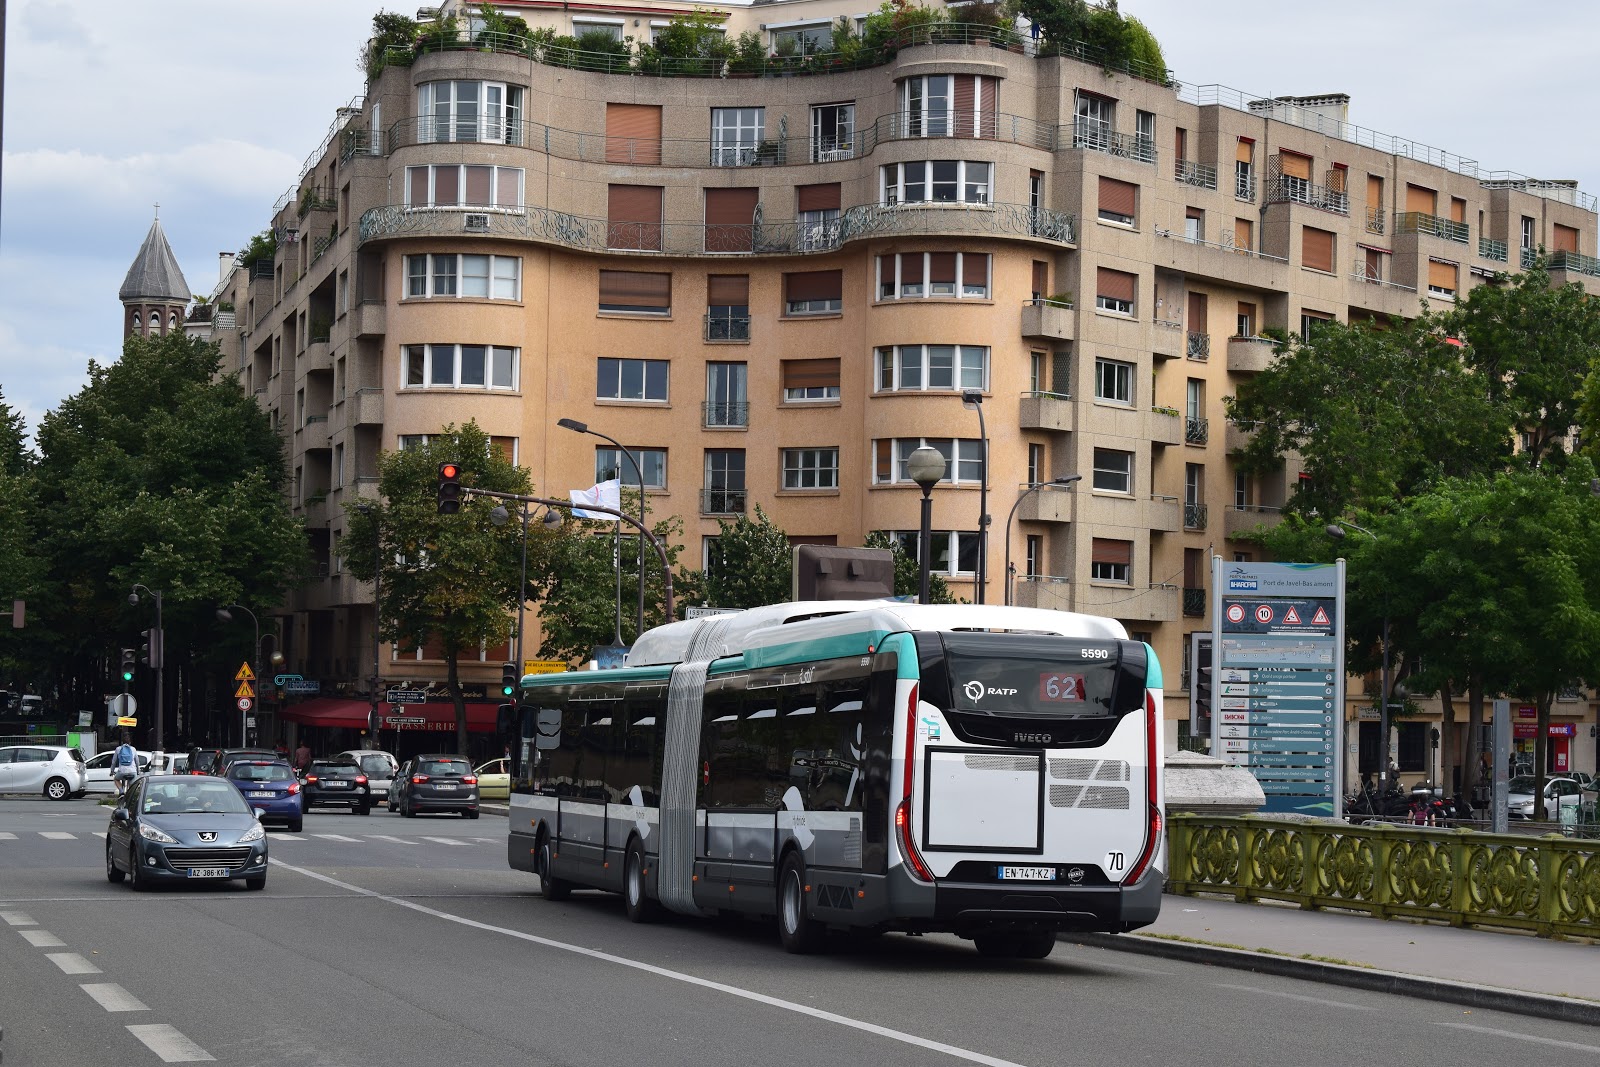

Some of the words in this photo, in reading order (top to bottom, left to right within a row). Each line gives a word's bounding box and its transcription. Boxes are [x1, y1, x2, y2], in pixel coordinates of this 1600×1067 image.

[1081, 649, 1108, 659] 5590
[988, 687, 1018, 695] RATP
[1046, 676, 1076, 699] 62
[391, 722, 455, 731] BRASSERIE
[1014, 733, 1052, 743] IVECO
[1108, 852, 1124, 870] 70
[1005, 868, 1049, 879] EN-747-KZ
